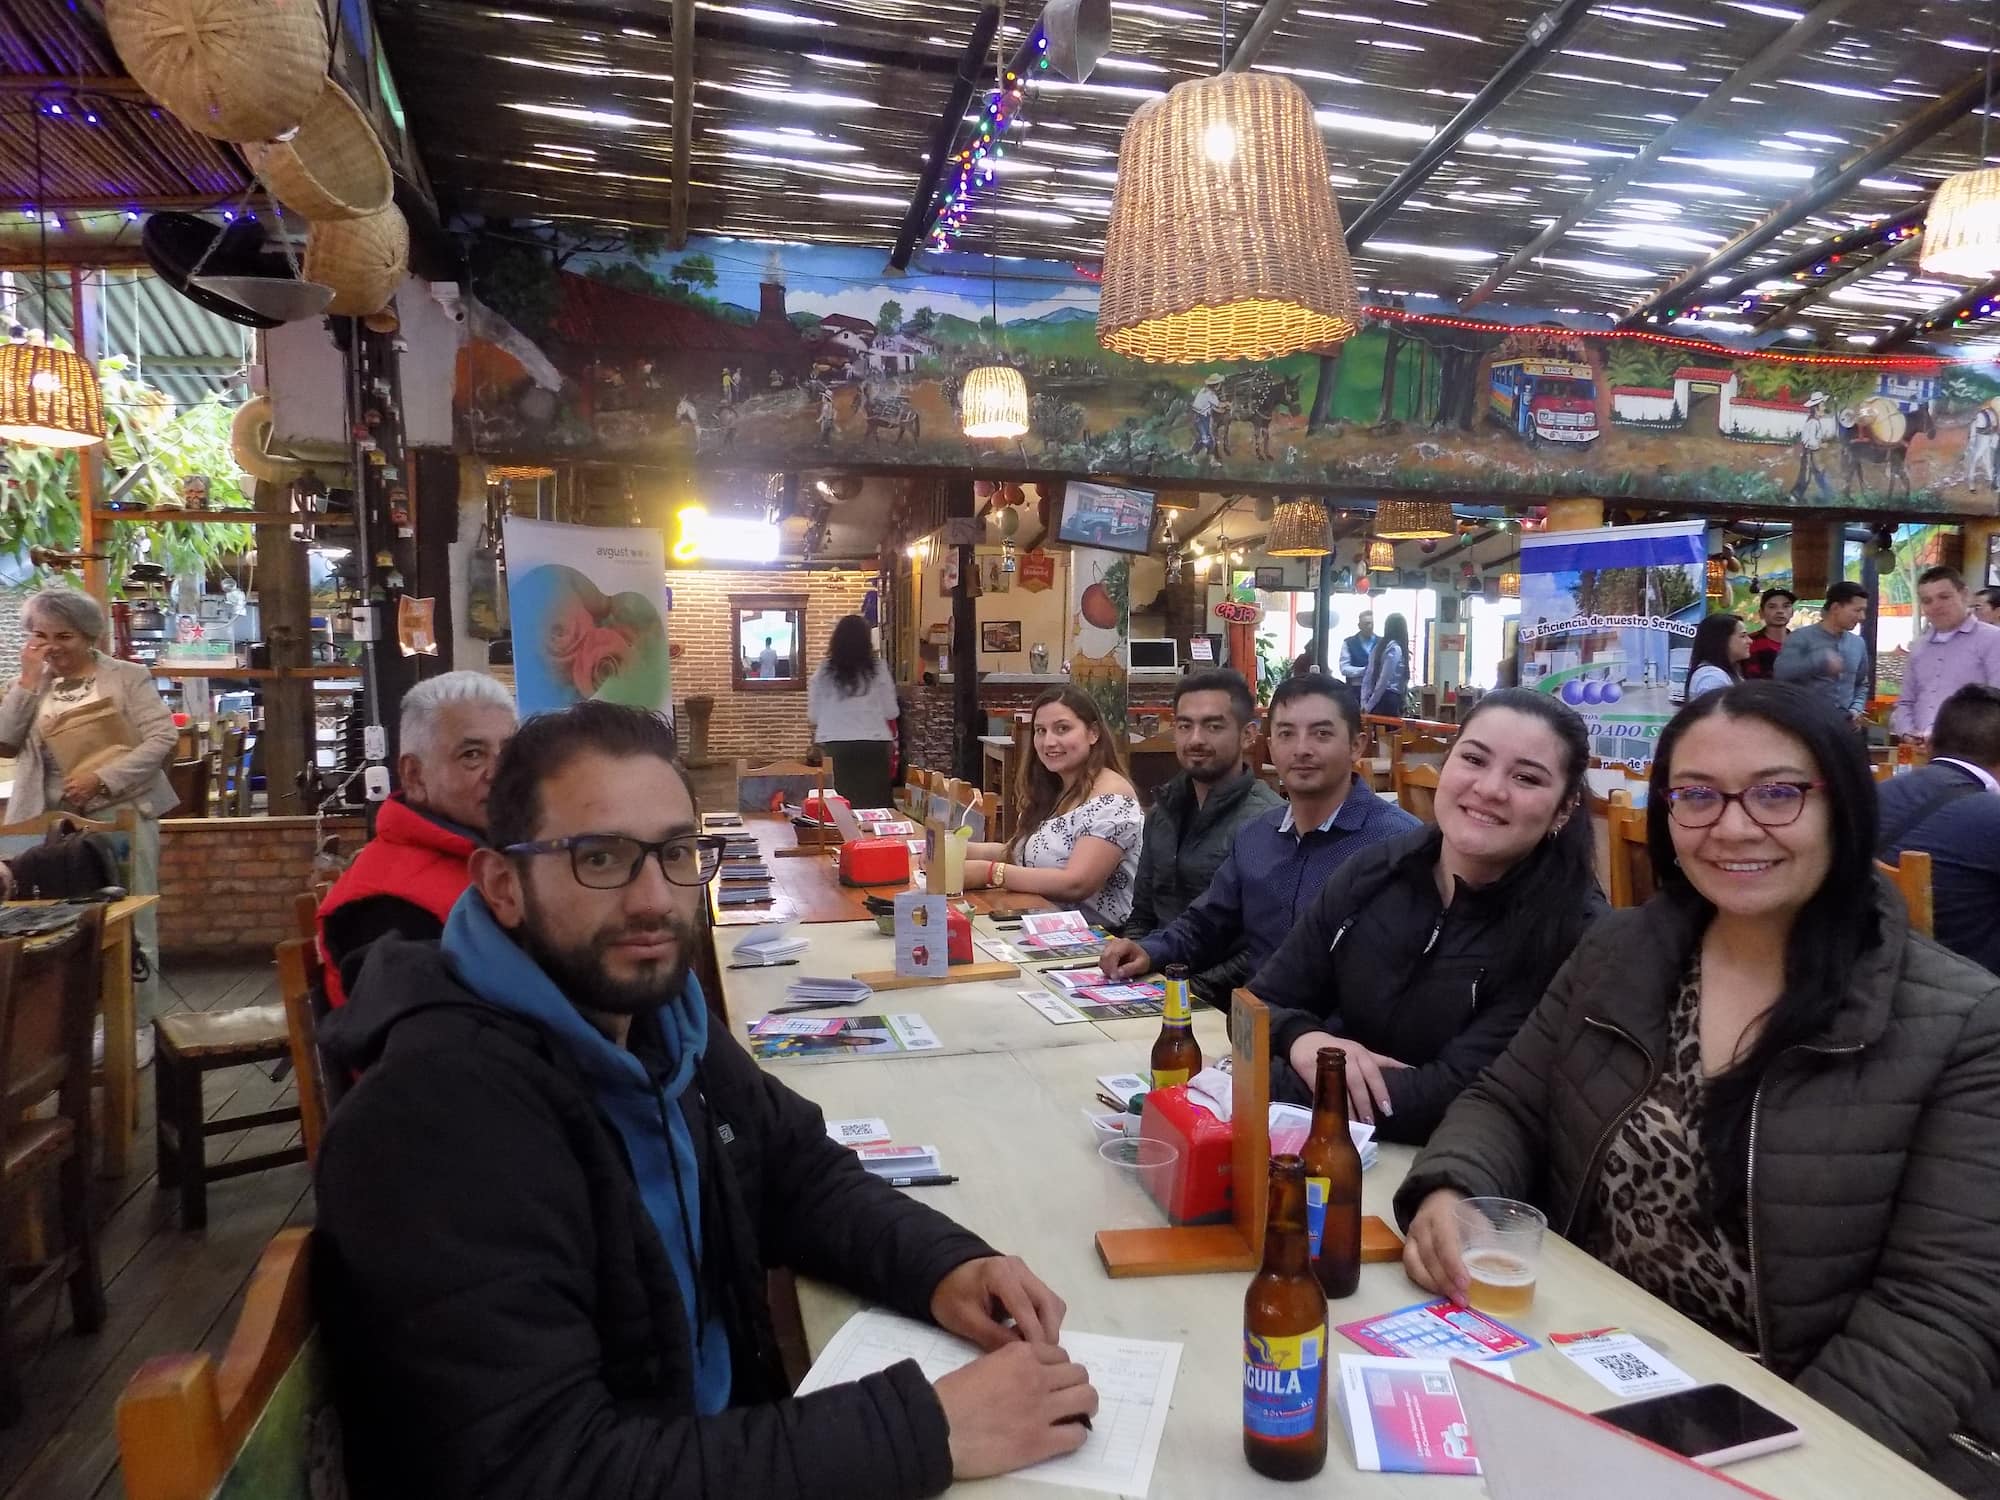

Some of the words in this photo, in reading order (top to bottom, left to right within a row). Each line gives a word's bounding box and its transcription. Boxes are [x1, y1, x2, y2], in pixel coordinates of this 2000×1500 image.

[596, 547, 629, 559] avgust
[1214, 602, 1256, 621] CAJA
[1522, 629, 1535, 639] La
[1537, 616, 1588, 635] Eficiencia
[1591, 615, 1603, 626] de
[1606, 616, 1649, 626] nuestro
[1651, 616, 1696, 637] Servicio
[1590, 723, 1641, 737] DADO
[1649, 726, 1660, 737] S
